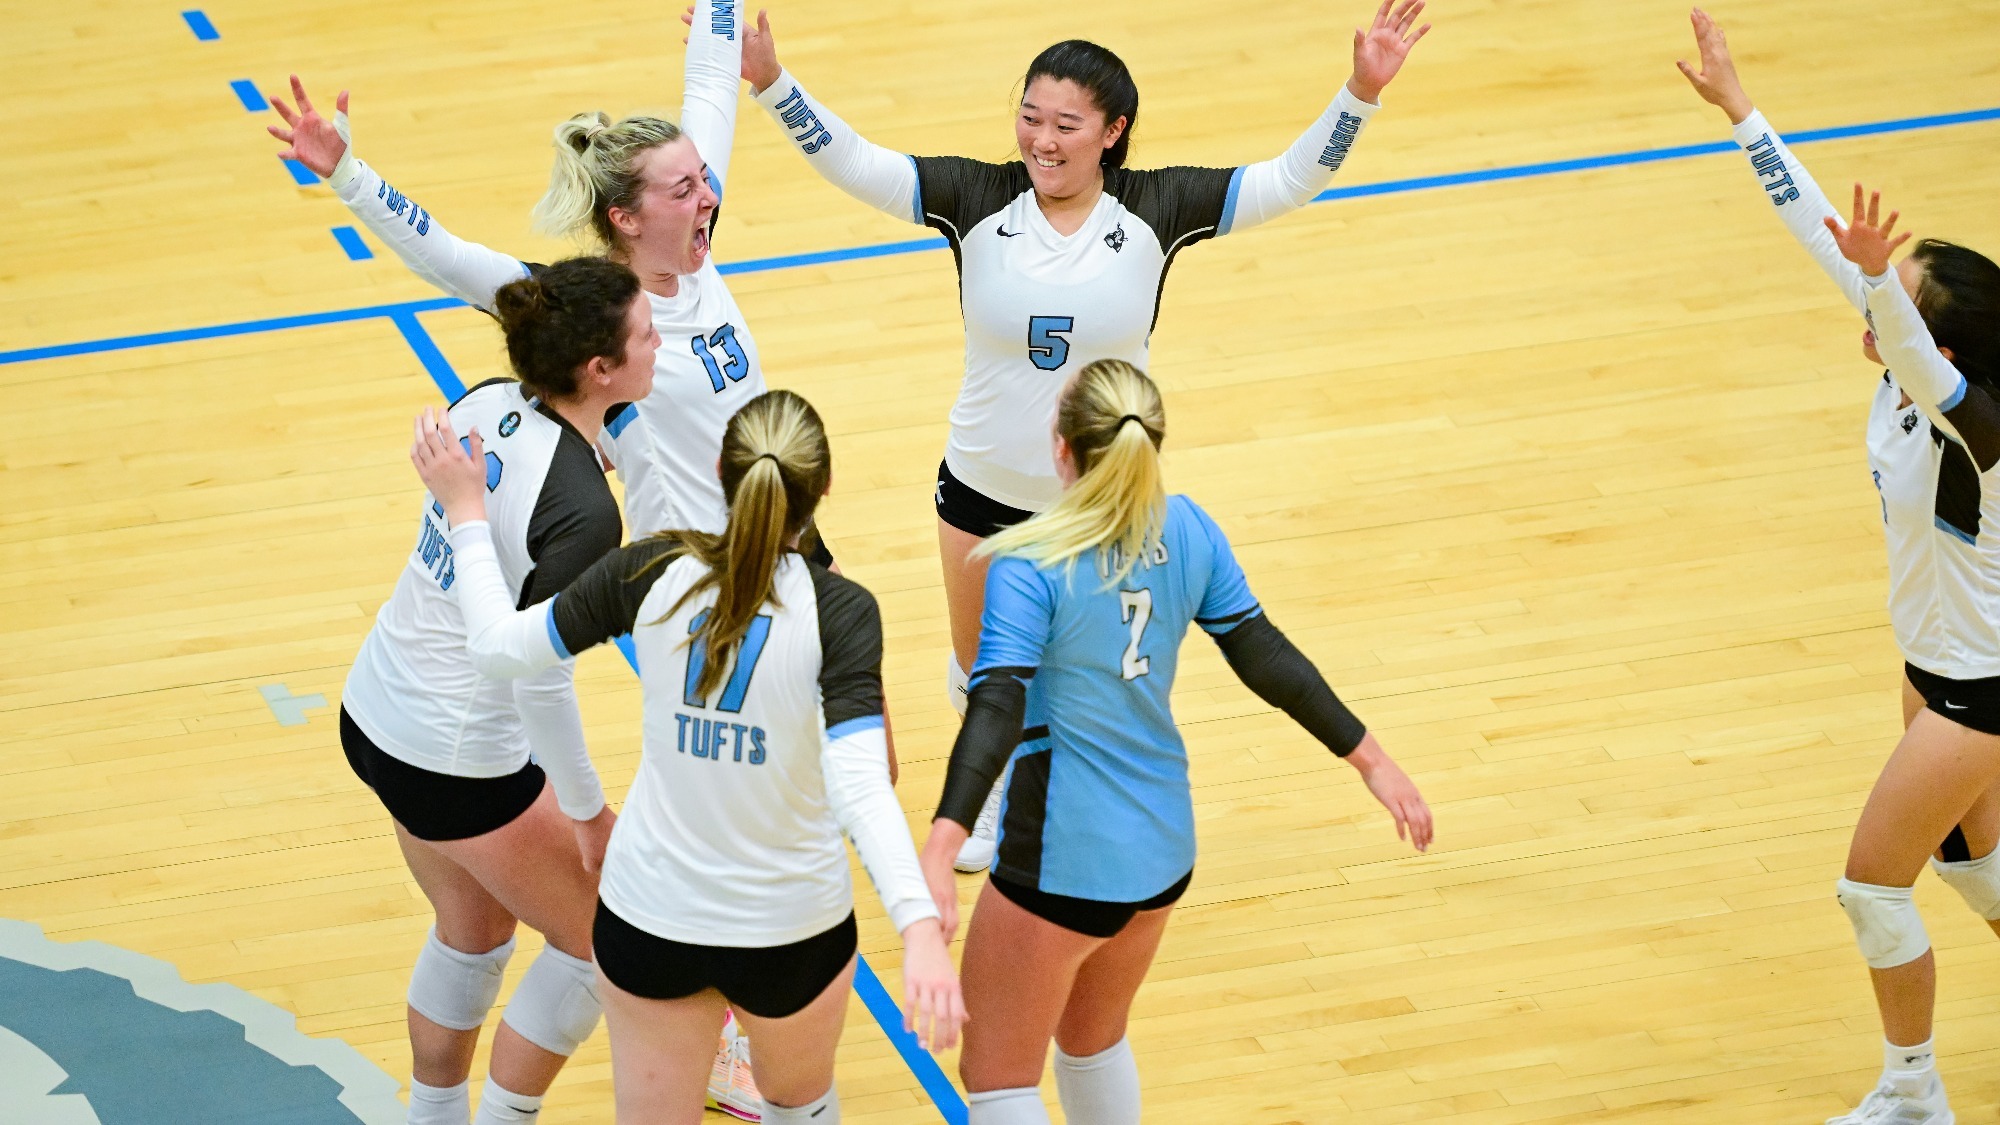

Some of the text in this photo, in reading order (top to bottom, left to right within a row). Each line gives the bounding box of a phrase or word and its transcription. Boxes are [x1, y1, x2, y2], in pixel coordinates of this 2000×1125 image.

[711, 0, 735, 41] JUM
[774, 85, 833, 155] TUFTS
[1317, 111, 1363, 172] JUMBOS
[1745, 132, 1801, 207] TUFTS
[690, 322, 750, 394] 13
[1028, 315, 1075, 371] 5
[1095, 524, 1169, 579] TUTS
[683, 605, 773, 714] 17
[1119, 587, 1153, 682] 2
[674, 712, 767, 765] TUFTS
